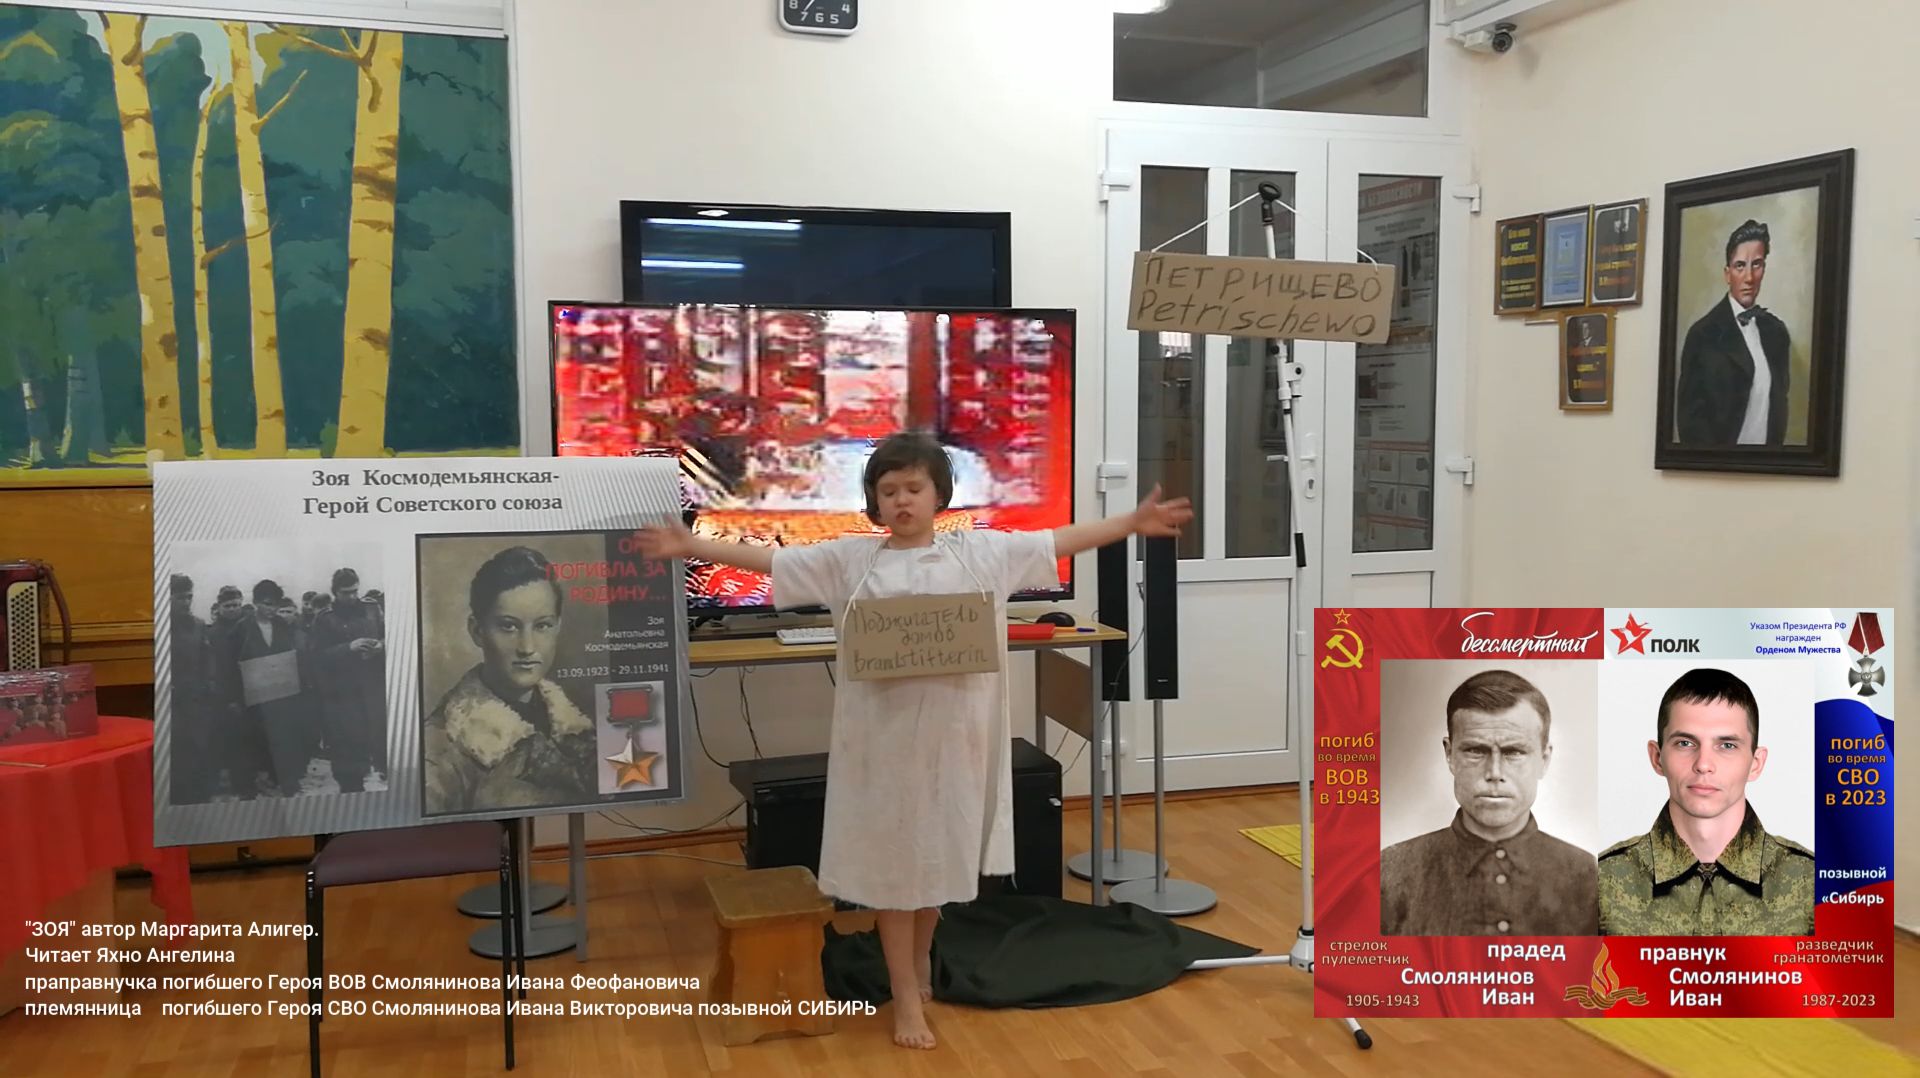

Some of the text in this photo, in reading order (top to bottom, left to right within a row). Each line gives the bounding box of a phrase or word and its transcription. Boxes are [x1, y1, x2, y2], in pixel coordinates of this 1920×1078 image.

[815, 12, 824, 22] 6
[830, 14, 839, 24] 5
[1144, 255, 1382, 302] ПЕТРИЩЕВО
[1137, 288, 1377, 336] Petrischewo
[312, 469, 560, 488] Зоя Космодемьянская-
[303, 496, 563, 518] Герой Советского союза
[545, 560, 667, 582] ПОГИБЛА ЗА
[647, 616, 665, 626] Зоя
[604, 630, 665, 639] Анатольевна
[902, 624, 956, 645] домов
[584, 641, 669, 653] Космодемьянская
[557, 666, 610, 679] 13.09.1923
[618, 664, 669, 676] 29.11.1941
